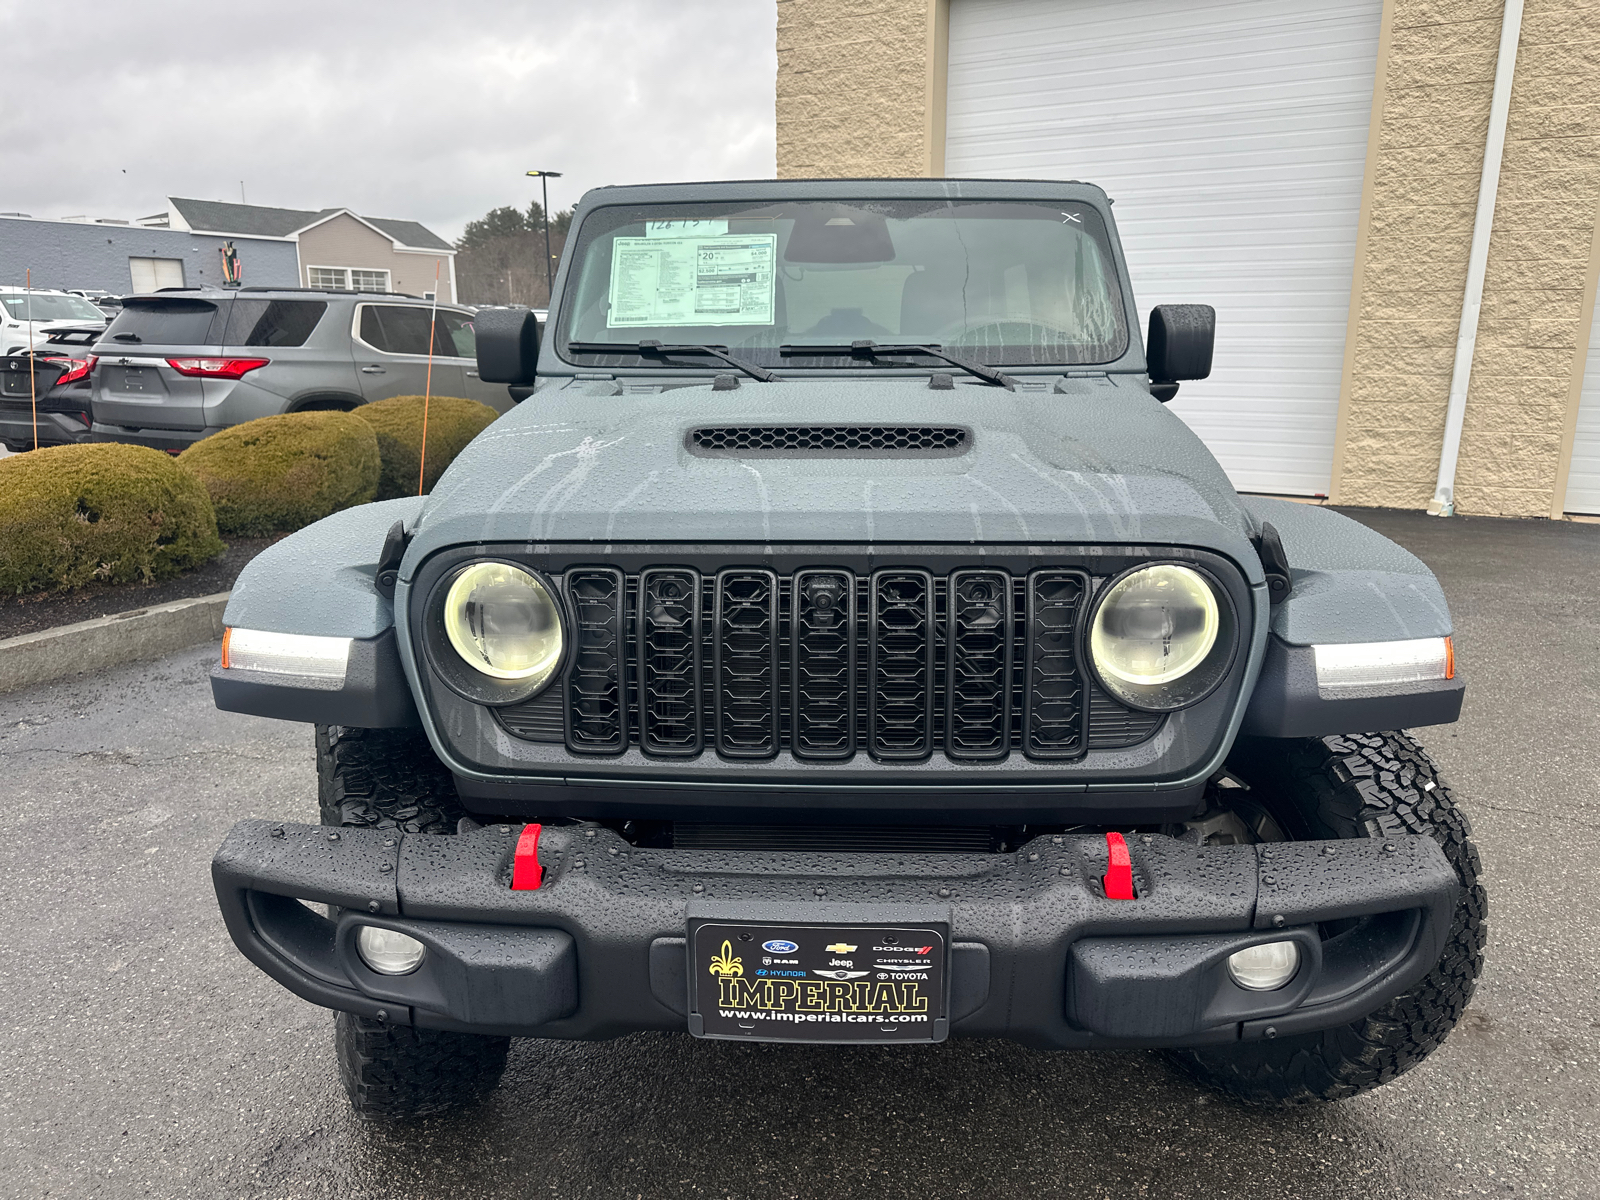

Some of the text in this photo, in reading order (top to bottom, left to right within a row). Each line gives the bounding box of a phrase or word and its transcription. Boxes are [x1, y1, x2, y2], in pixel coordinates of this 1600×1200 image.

[702, 252, 714, 260] 20
[770, 942, 790, 951] Ford
[828, 957, 854, 969] Jeep
[770, 969, 807, 977] HYUNDAI
[889, 972, 929, 980] TOYOTA
[718, 976, 928, 1013] IMPERIAL
[718, 1009, 928, 1023] www.imperialcars.com
